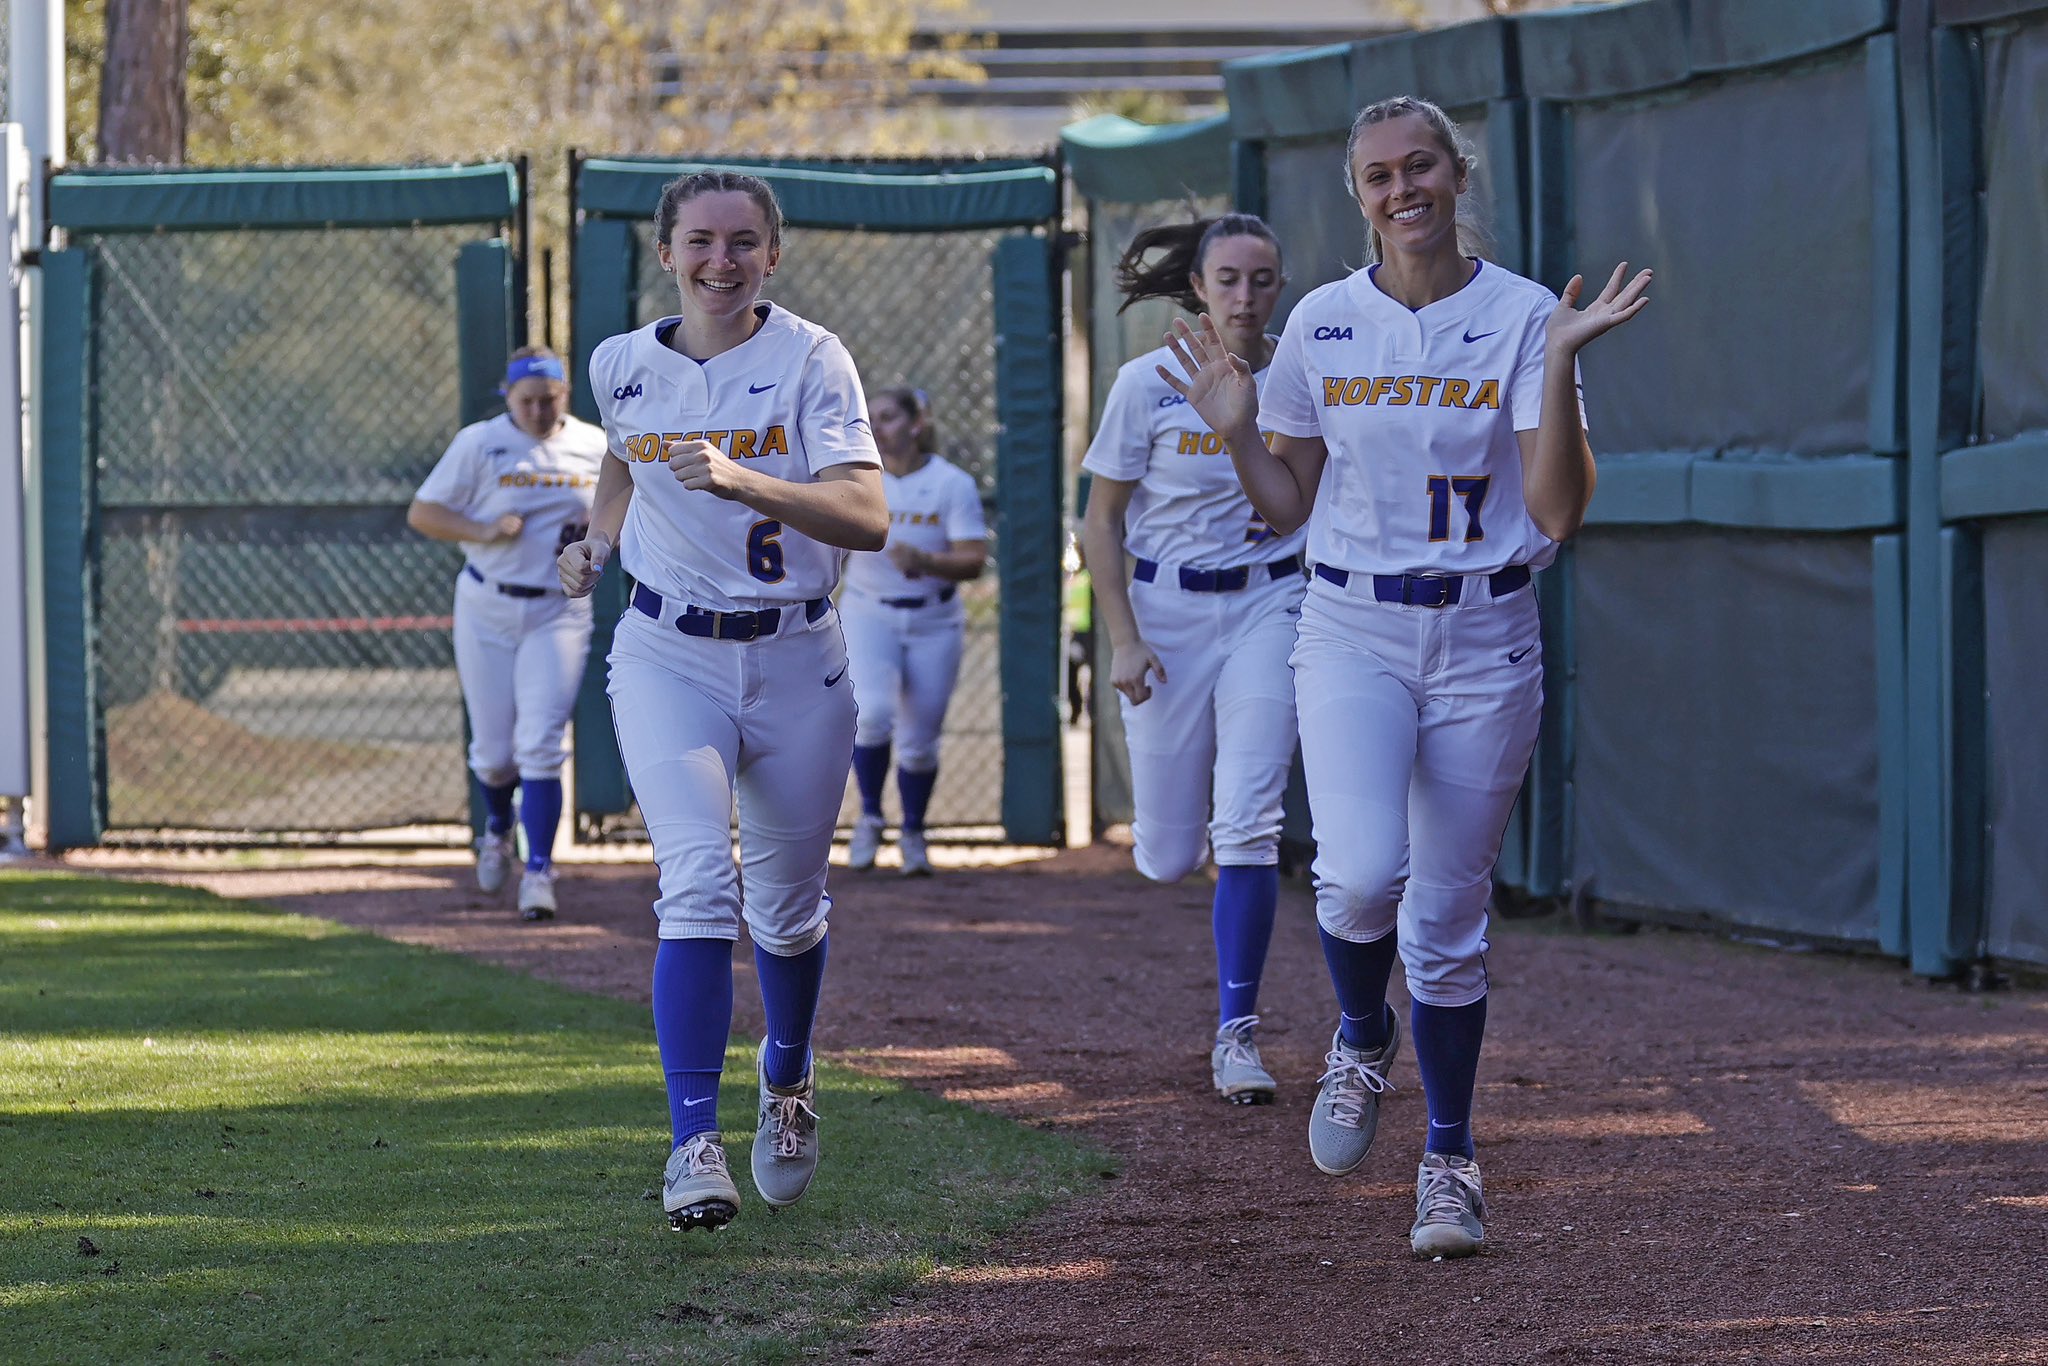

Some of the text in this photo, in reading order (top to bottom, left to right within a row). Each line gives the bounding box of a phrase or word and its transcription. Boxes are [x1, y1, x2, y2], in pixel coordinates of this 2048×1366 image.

[1313, 326, 1353, 341] CAA
[613, 384, 643, 400] CAA
[1322, 375, 1501, 410] HOFSTRA
[1426, 474, 1491, 543] 17
[746, 517, 787, 584] 6
